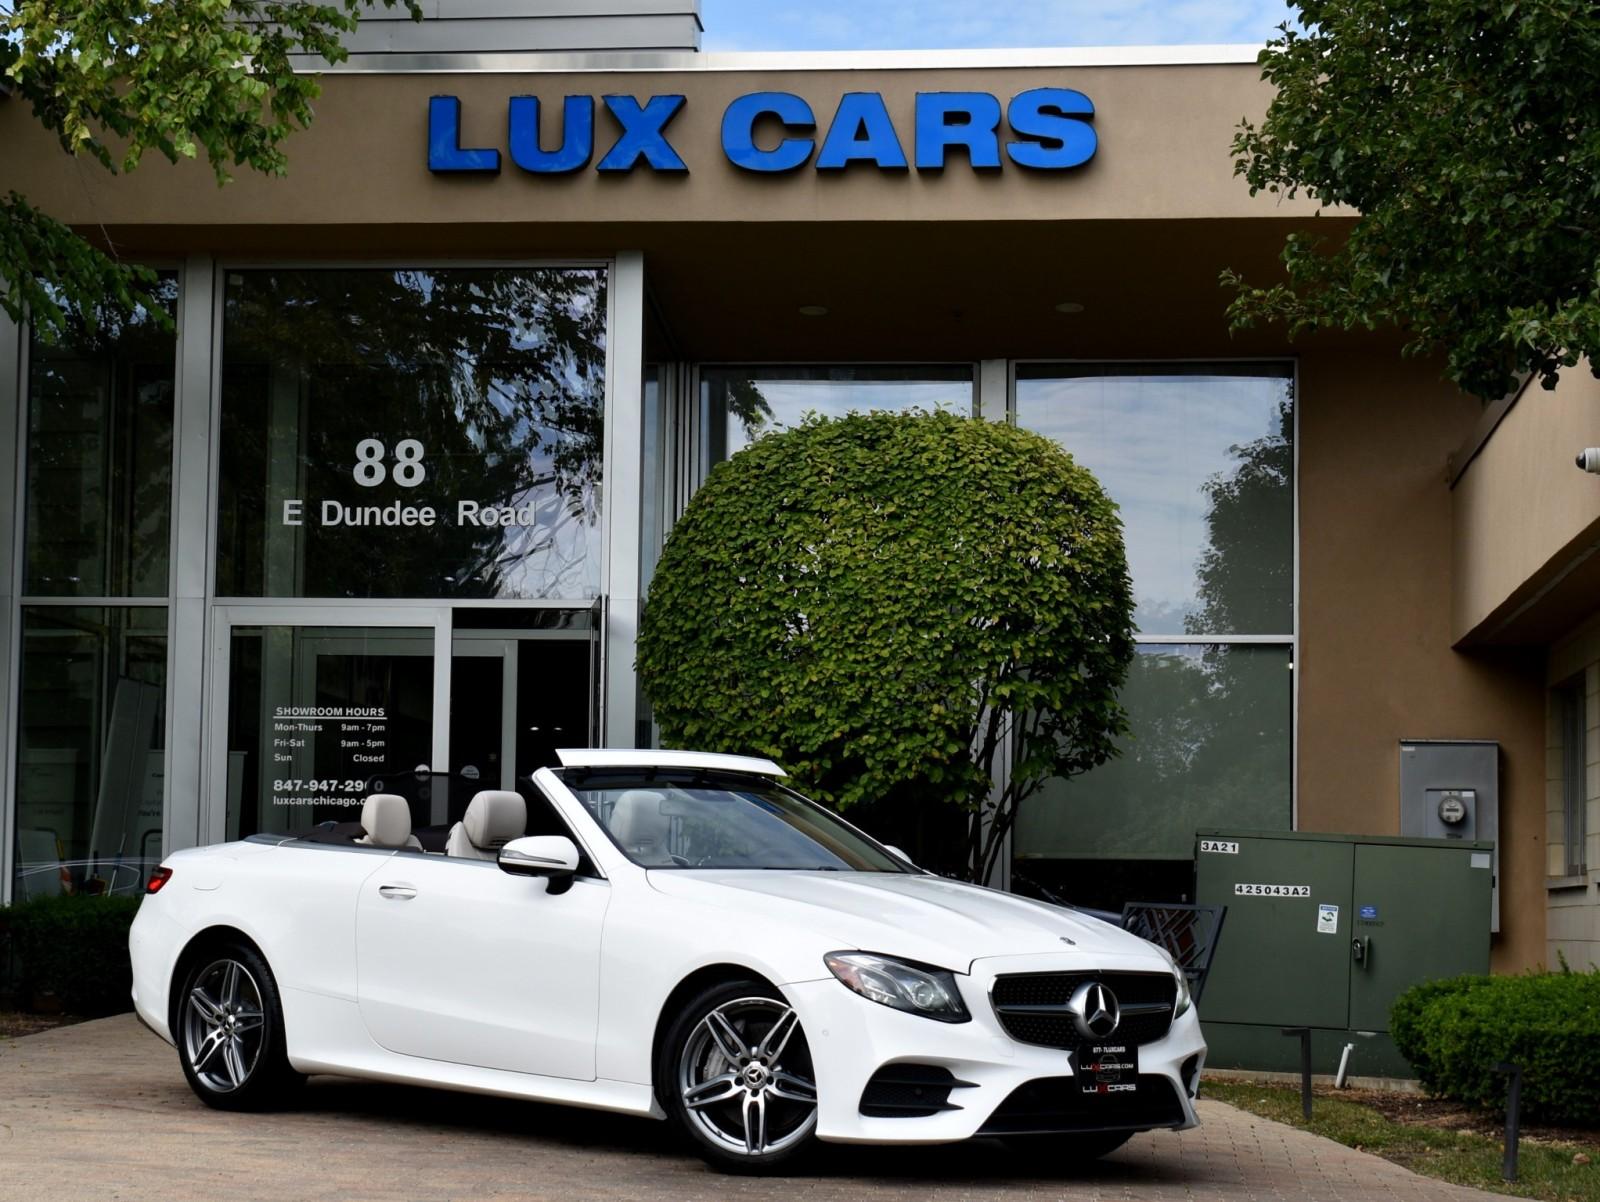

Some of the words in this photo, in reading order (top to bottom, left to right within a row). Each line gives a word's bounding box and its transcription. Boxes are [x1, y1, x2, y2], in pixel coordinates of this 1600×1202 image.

[428, 94, 689, 173] LUX
[720, 87, 1098, 173] CARS
[353, 438, 426, 487] 88
[283, 500, 303, 526] E
[321, 500, 436, 526] Dundee
[457, 500, 536, 526] Road
[276, 707, 342, 716] SHOWROOM
[345, 707, 385, 716] HOURS
[274, 723, 323, 731] Mon-Thurs
[341, 723, 359, 731] 9am
[366, 723, 385, 733] 7pm
[274, 739, 305, 747] Fri-Sat
[366, 740, 385, 748] 5pm
[274, 753, 292, 761] Sun
[353, 754, 385, 762] Closed
[273, 780, 384, 792] 847-947-290
[1202, 842, 1236, 852] 3A21
[1236, 885, 1309, 896] 425043A2
